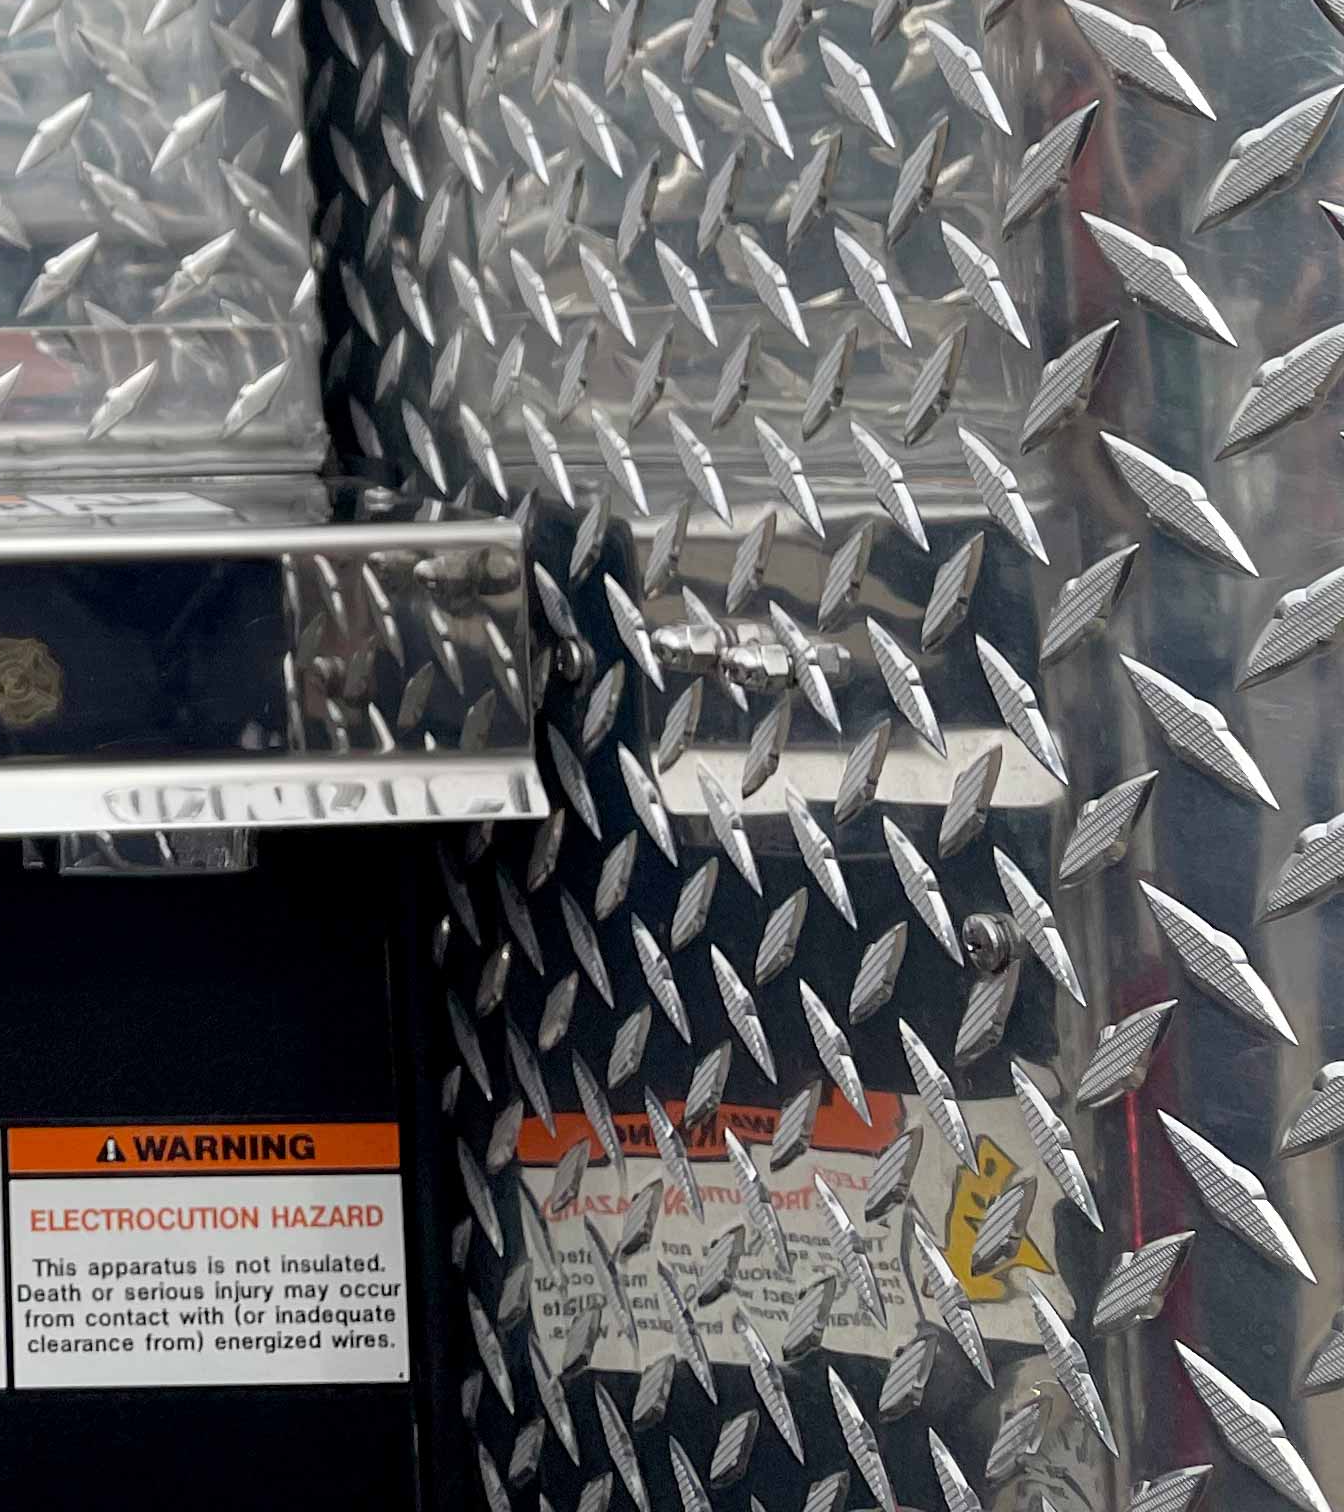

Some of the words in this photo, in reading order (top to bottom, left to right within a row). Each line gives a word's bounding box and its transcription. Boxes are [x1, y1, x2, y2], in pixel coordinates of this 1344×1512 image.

[132, 1135, 316, 1162] WARNING
[30, 1207, 259, 1232] ELECTROCUTION
[271, 1205, 384, 1228] HAZARD
[32, 1257, 77, 1276] This
[88, 1257, 197, 1279] apparatus
[208, 1256, 225, 1274] is
[236, 1256, 271, 1273] not
[281, 1254, 386, 1272] insulated.
[17, 1283, 81, 1302] Death
[91, 1286, 114, 1301] or
[124, 1281, 204, 1300] serious
[215, 1281, 274, 1302] injury
[284, 1283, 329, 1301] may
[339, 1282, 402, 1298] occur
[24, 1308, 75, 1327] from
[85, 1308, 170, 1327] contact
[179, 1306, 224, 1325] with
[234, 1303, 266, 1326] (or
[275, 1305, 396, 1327] inadequate
[27, 1334, 134, 1353] clearance
[146, 1330, 204, 1352] from)
[215, 1330, 322, 1354] energized
[332, 1329, 396, 1348] wires.
